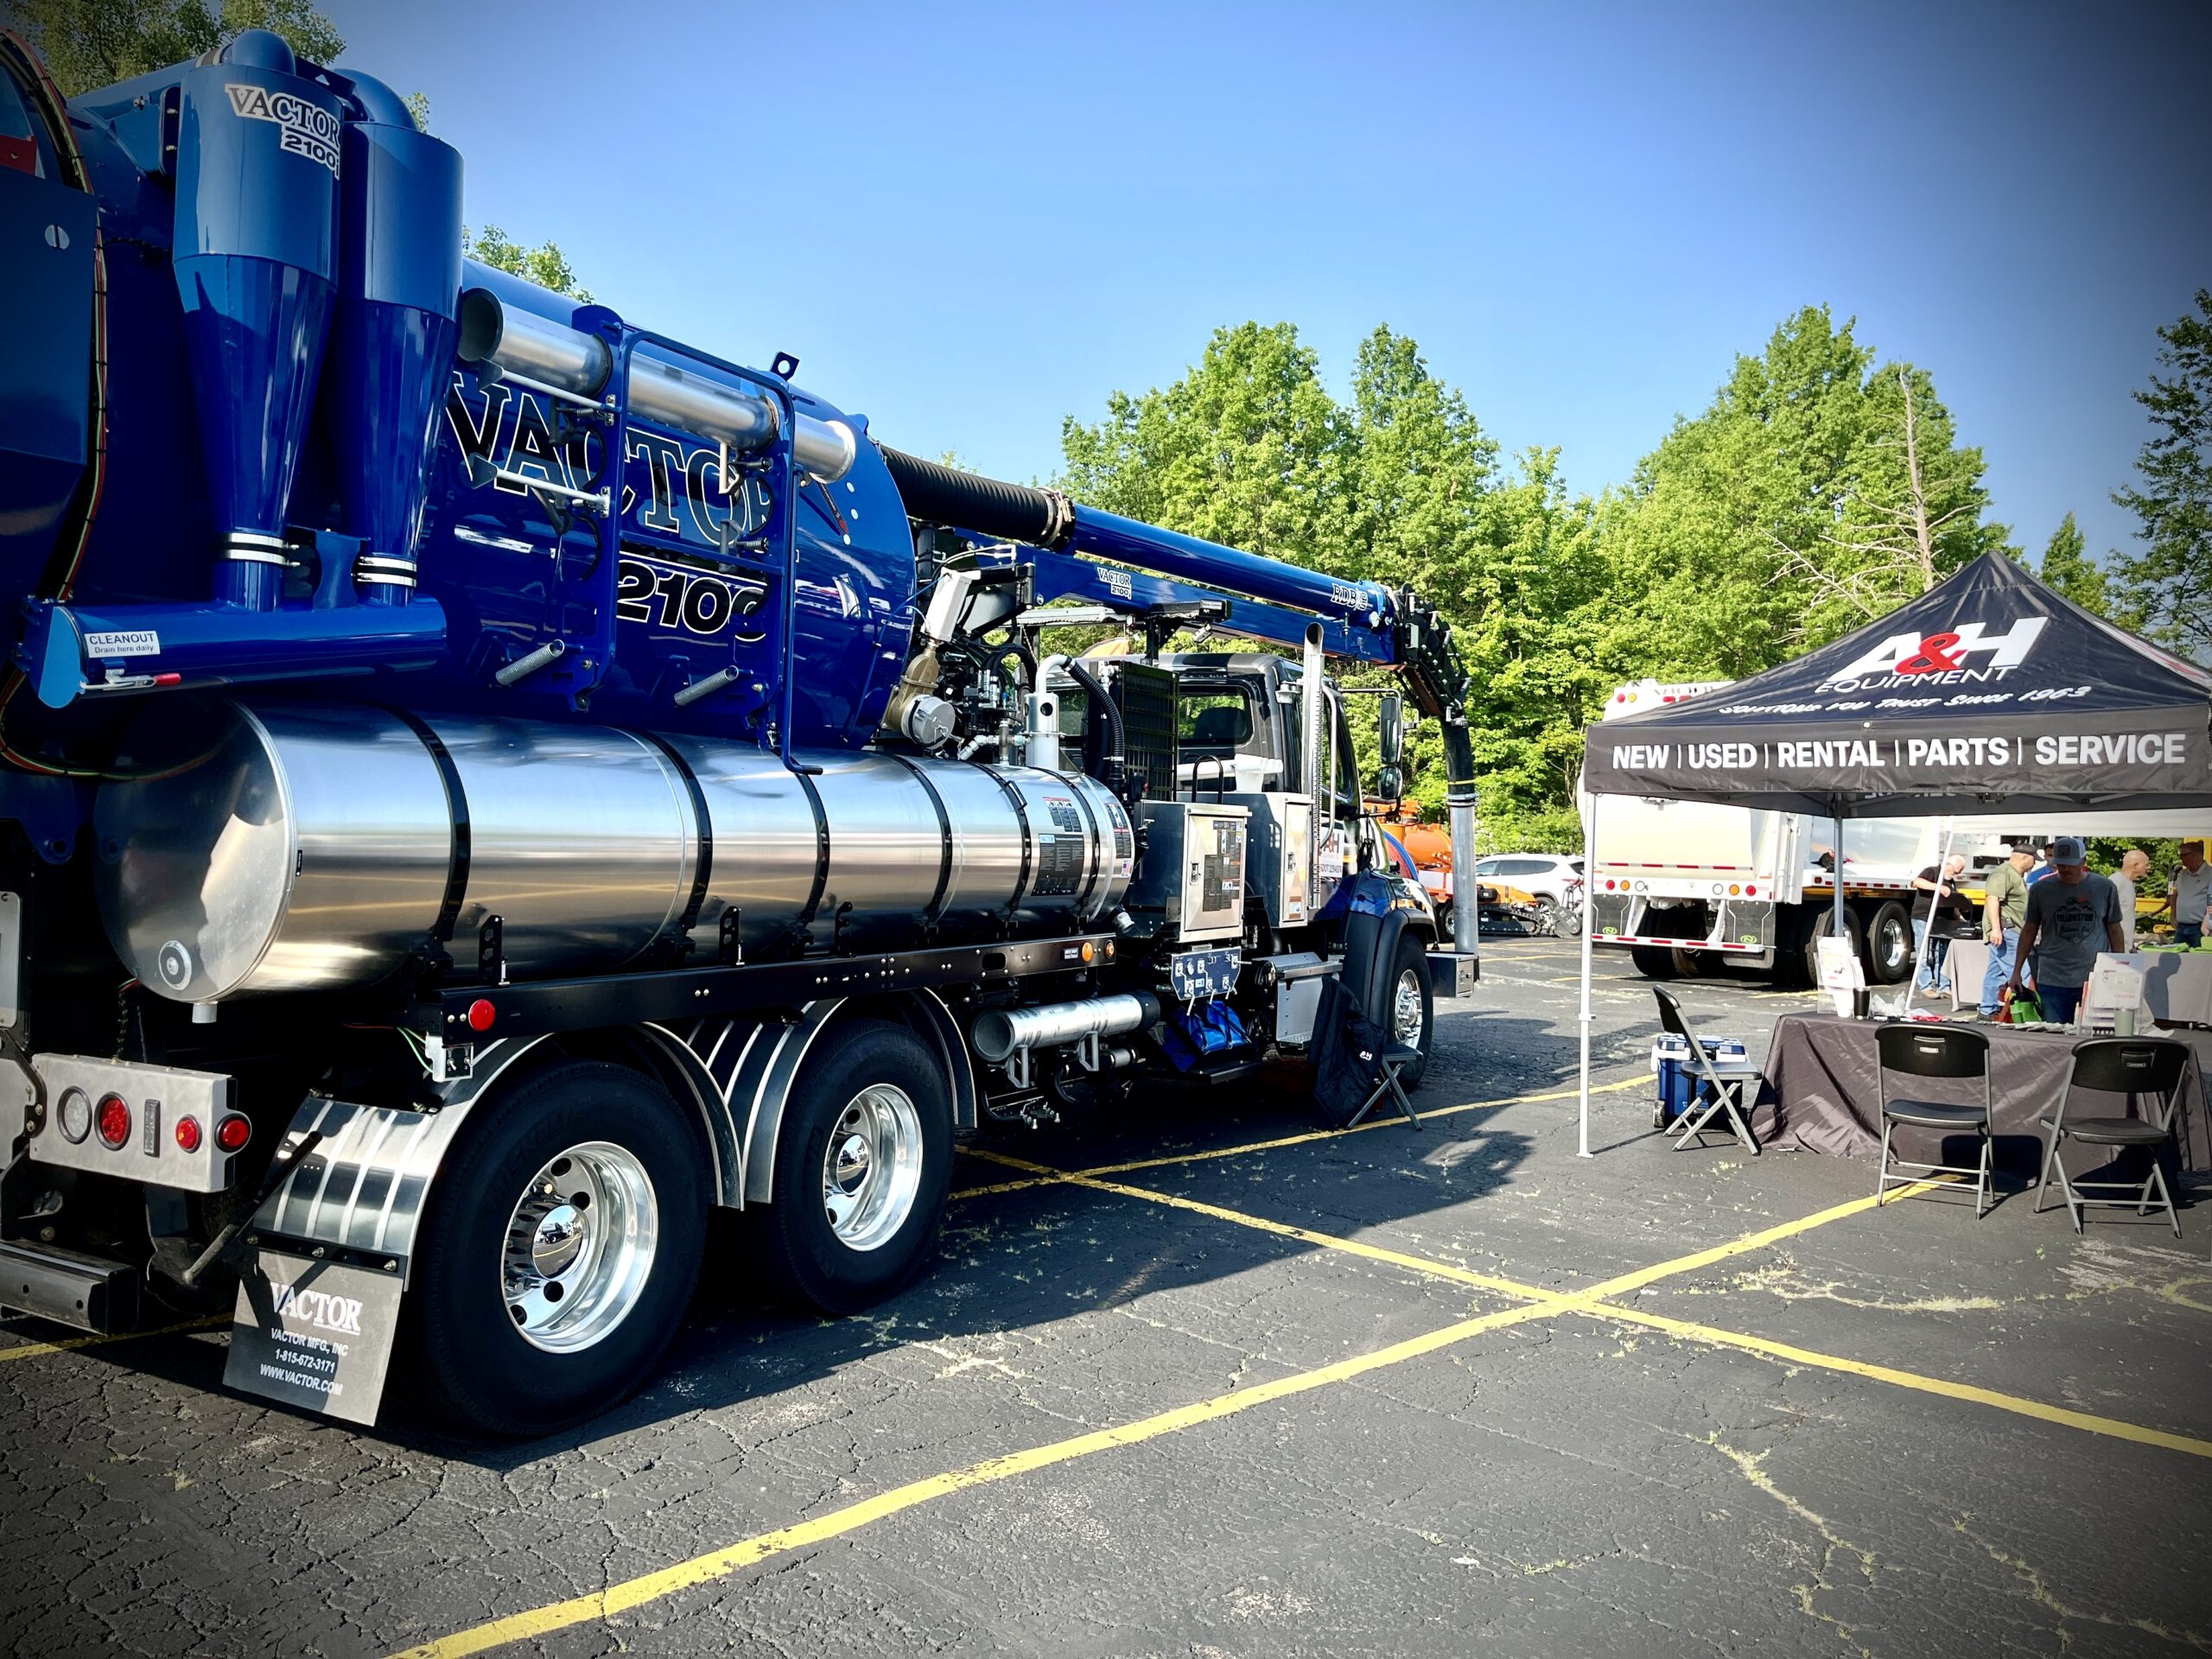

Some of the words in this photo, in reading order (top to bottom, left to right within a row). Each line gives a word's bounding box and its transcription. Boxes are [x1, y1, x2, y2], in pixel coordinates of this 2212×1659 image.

[226, 85, 340, 149] VACTOR
[1098, 568, 1131, 586] VACTOR
[89, 633, 155, 645] CLEANOUT
[136, 644, 154, 652] daily
[1826, 616, 2049, 683] A&H
[1814, 664, 2019, 694] EQUIPMENT
[1825, 701, 1872, 711] YOU
[1874, 697, 1942, 709] TRUST
[1943, 693, 2014, 707] SINCE
[2018, 685, 2092, 702] 1963
[1611, 744, 1669, 770] NEW
[1688, 742, 1758, 769] USED
[1777, 740, 1886, 768] RENTAL
[1907, 737, 2011, 766] PARTS
[2035, 734, 2187, 765] SERVICE
[270, 1281, 363, 1332] VACTOR
[270, 1327, 307, 1347] VACTOR
[331, 1342, 349, 1357] INC
[275, 1348, 335, 1374] 1-815-672-3171
[259, 1363, 344, 1396] WWW.VACTOR.COM
